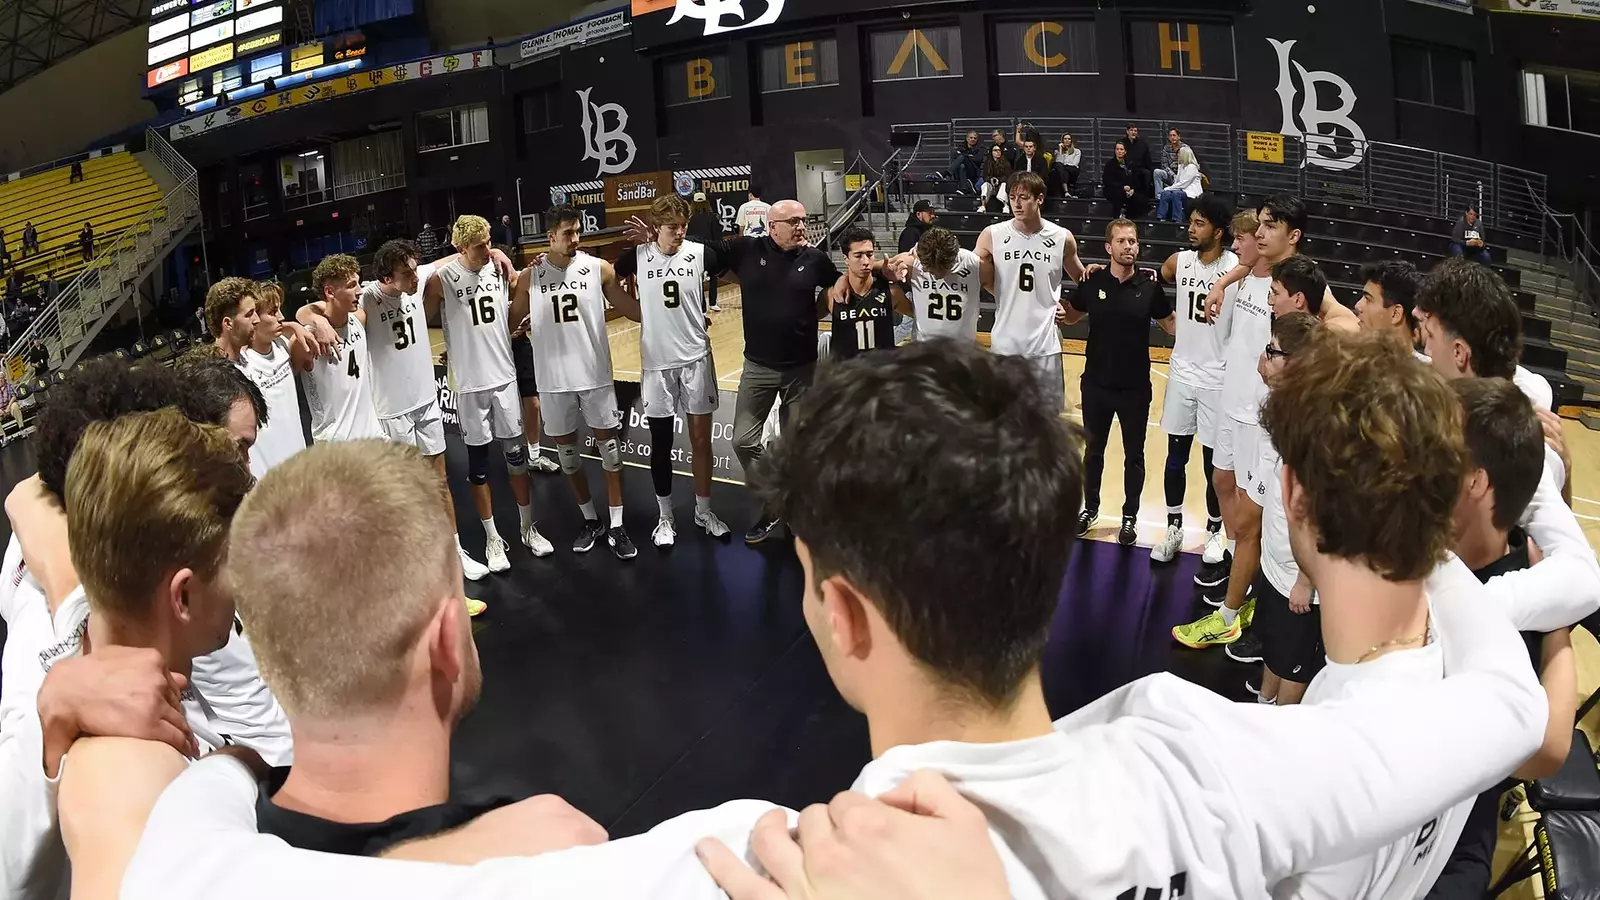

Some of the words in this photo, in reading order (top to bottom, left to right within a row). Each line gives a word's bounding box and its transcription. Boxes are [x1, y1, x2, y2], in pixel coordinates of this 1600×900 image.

[521, 35, 545, 50] GLENN
[552, 25, 584, 41] THOMAS
[618, 180, 654, 188] Courtside
[702, 179, 749, 194] PACIFICO
[617, 186, 657, 201] SandBar
[1004, 250, 1051, 262] BEACH
[650, 268, 694, 279] BEACH
[1019, 263, 1035, 292] 6
[456, 282, 500, 298] BEACH
[540, 280, 588, 294] BEACH
[922, 280, 969, 292] BEACH
[1181, 277, 1214, 291] BEAC
[662, 280, 681, 308] 9
[468, 295, 496, 326] 16
[551, 293, 579, 323] 12
[840, 308, 887, 321] BEACH
[928, 293, 962, 321] 26
[392, 316, 416, 351] 31
[855, 320, 876, 350] 11
[347, 349, 360, 380] 4
